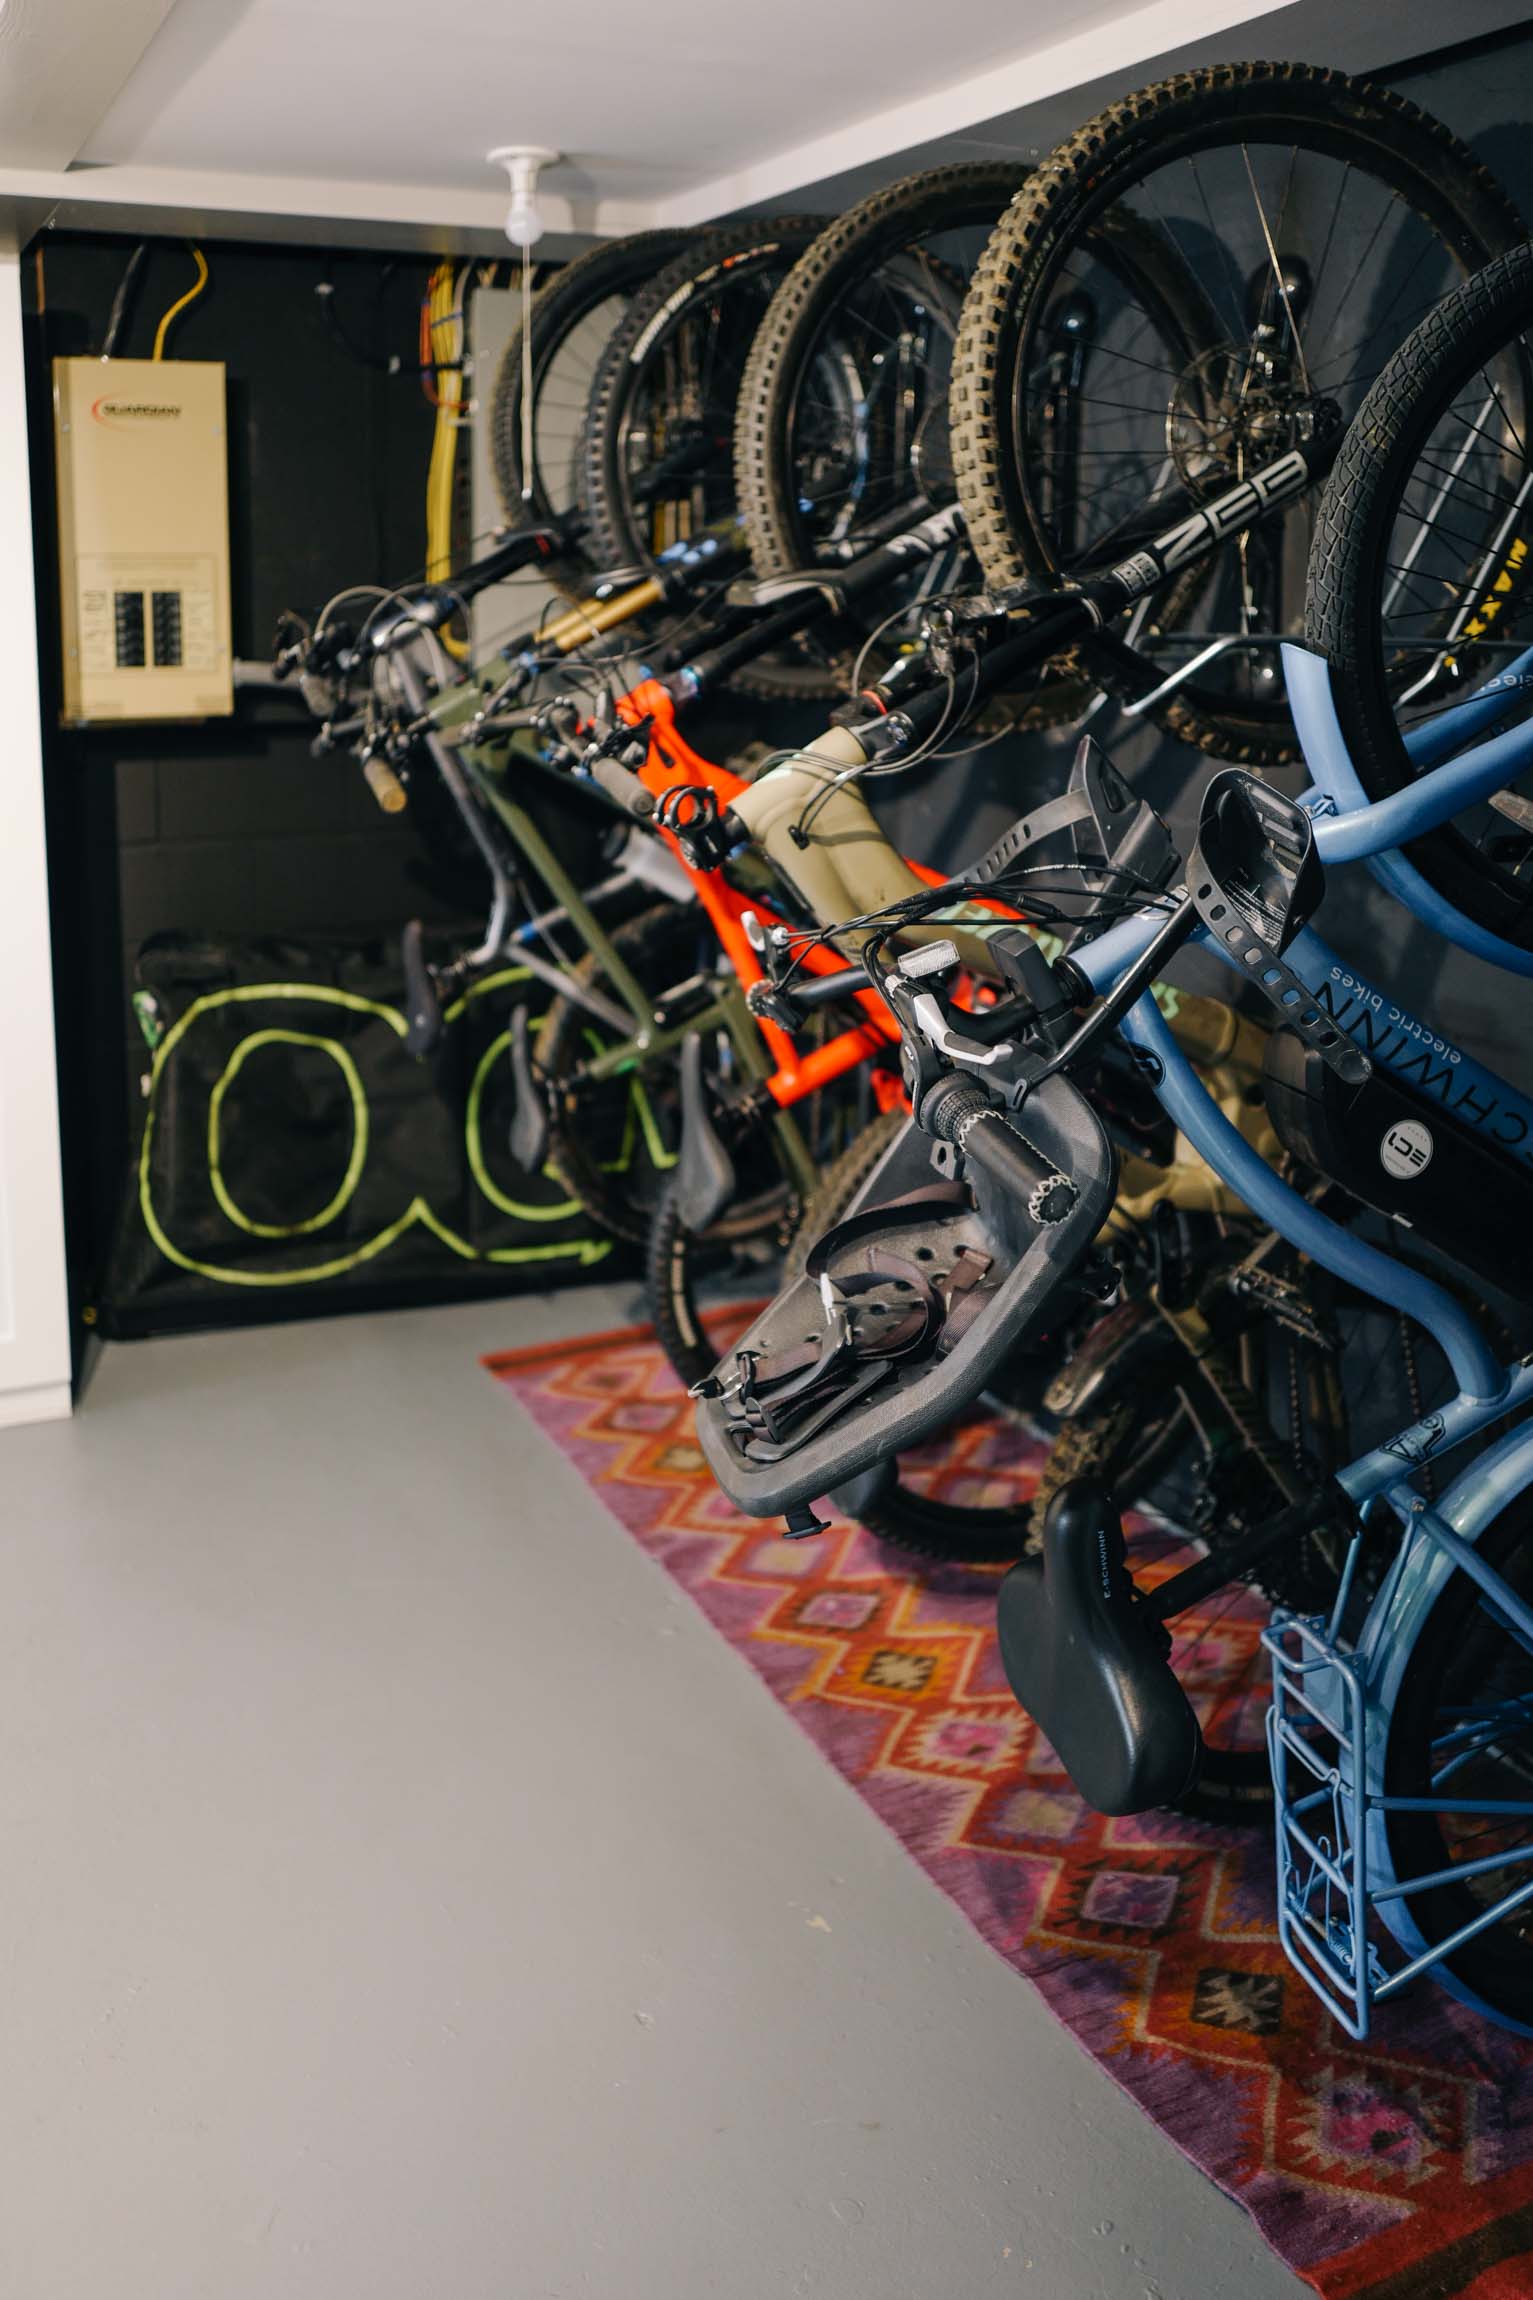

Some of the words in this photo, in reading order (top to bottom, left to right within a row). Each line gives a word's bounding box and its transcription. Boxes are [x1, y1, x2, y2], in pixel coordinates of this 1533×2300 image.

[1330, 966, 1384, 1013] bikes
[1389, 1006, 1461, 1064] electric
[1314, 981, 1533, 1164] CHWINN
